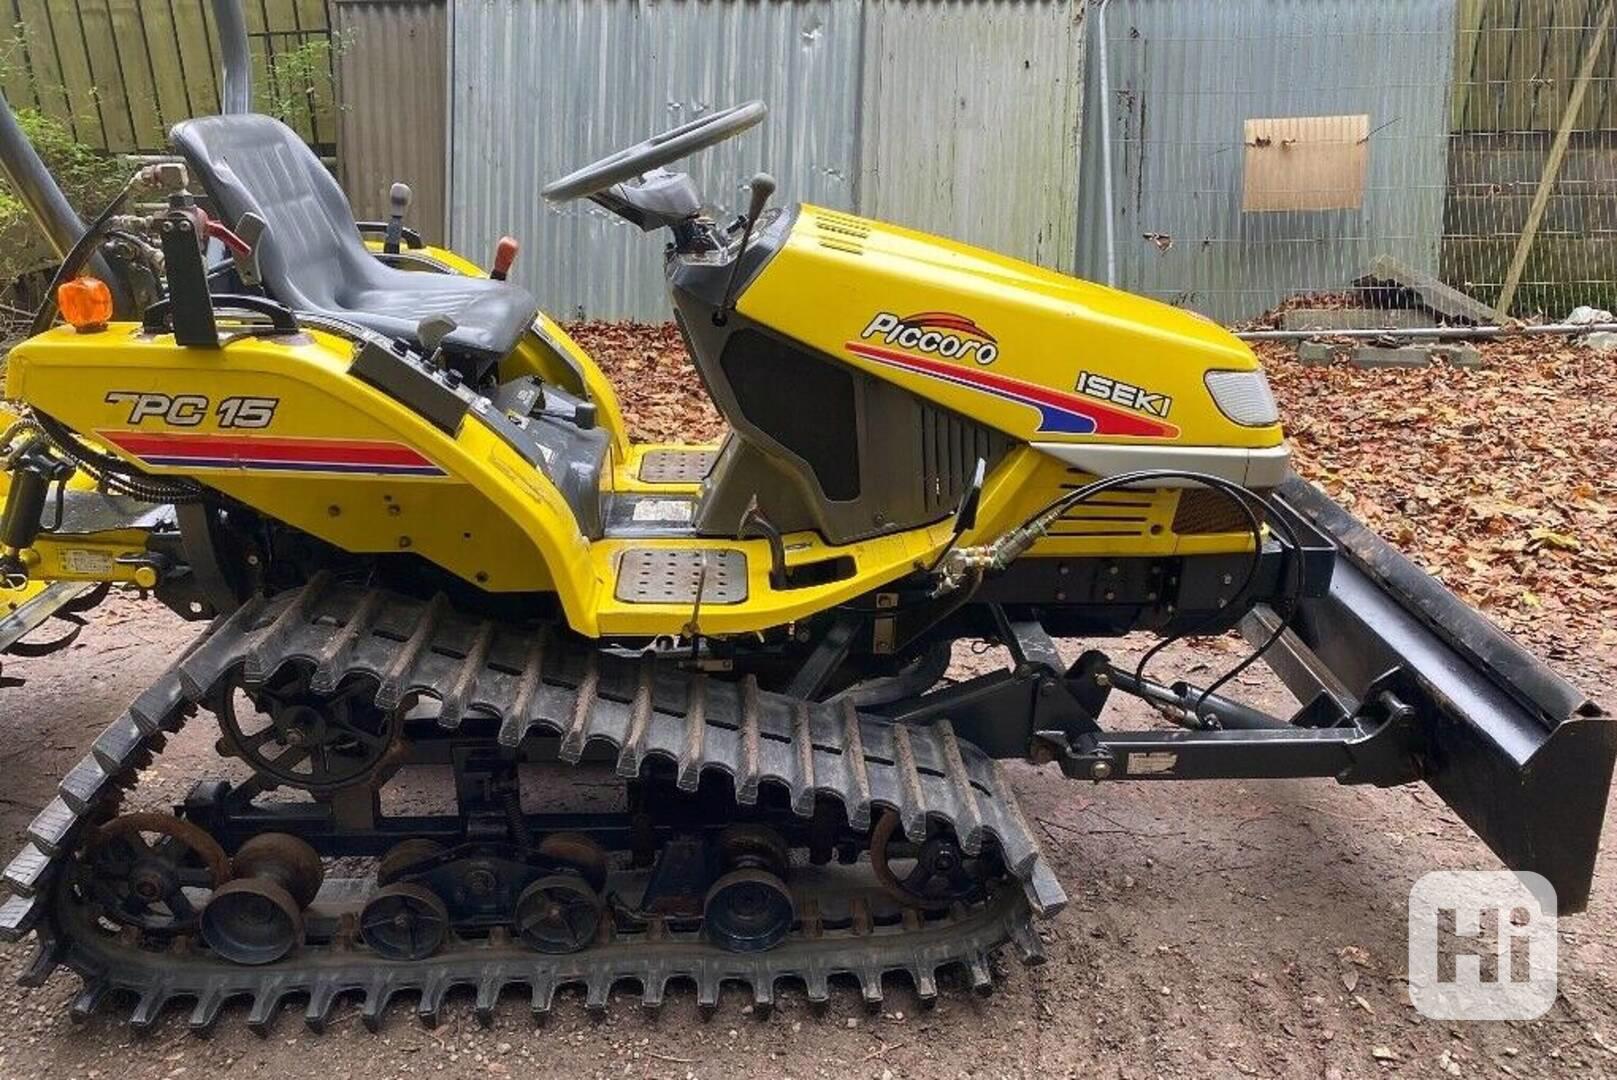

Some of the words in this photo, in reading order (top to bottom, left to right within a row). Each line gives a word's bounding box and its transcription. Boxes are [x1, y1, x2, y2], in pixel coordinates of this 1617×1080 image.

[860, 312, 999, 365] Piccoro
[216, 396, 279, 429] 15
[1075, 370, 1172, 418] ISEKI
